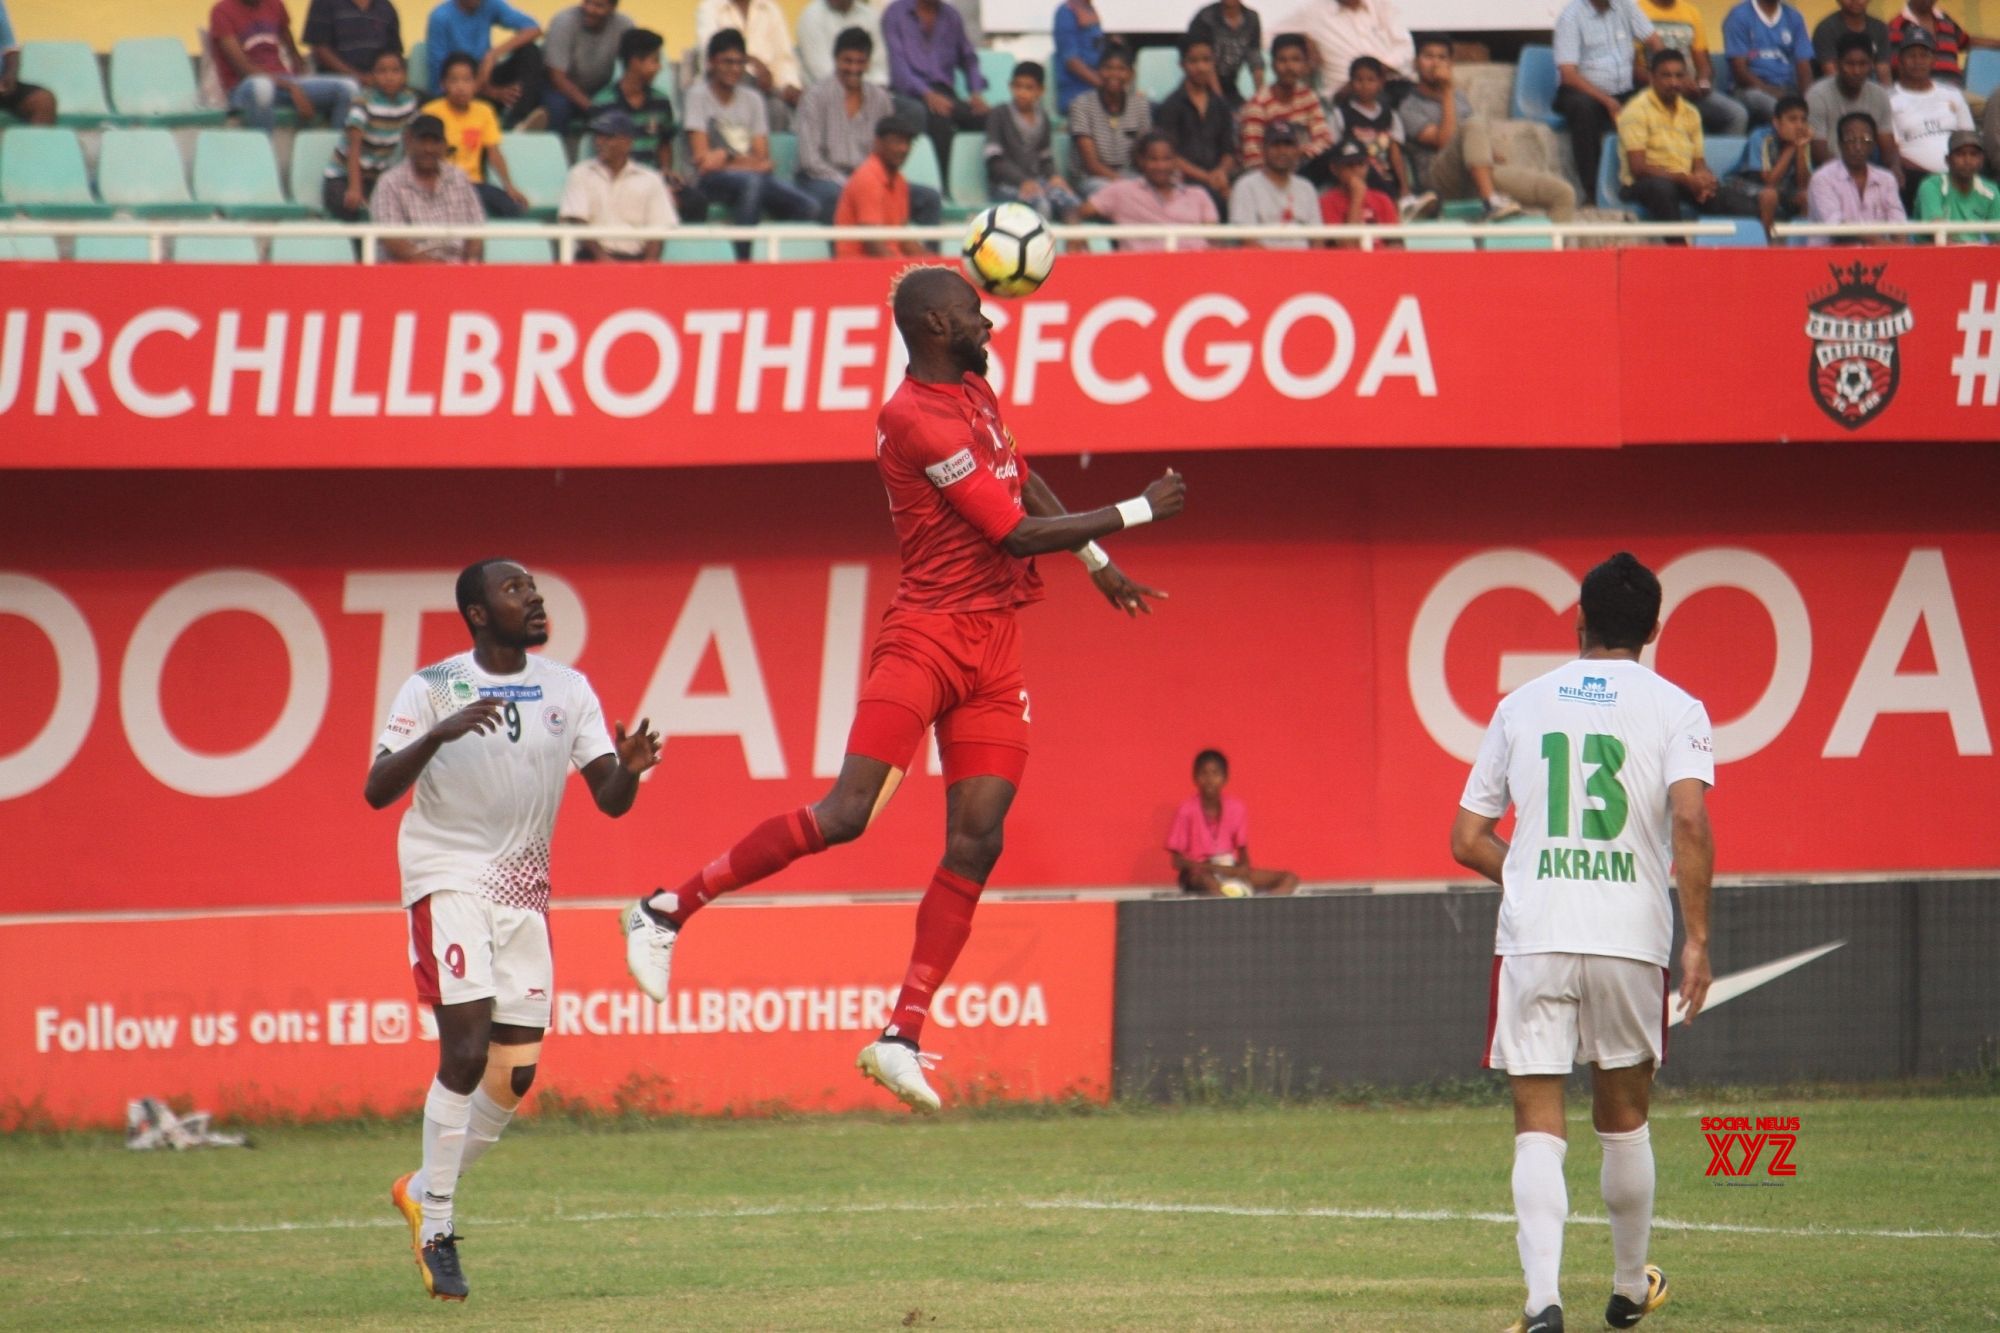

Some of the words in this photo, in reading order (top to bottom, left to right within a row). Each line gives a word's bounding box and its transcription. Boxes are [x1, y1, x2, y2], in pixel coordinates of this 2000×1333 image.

[1407, 546, 1994, 766] GOA
[1558, 686, 1618, 700] Nilkamal
[504, 701, 521, 743] 9
[1541, 731, 1628, 841] 13
[1537, 848, 1637, 883] AKRAM
[444, 943, 466, 979] 9
[35, 1003, 178, 1052] Follow
[191, 1013, 238, 1046] us
[250, 1010, 320, 1043] on:
[549, 981, 1048, 1035] RCHILLBROTHERCGOA
